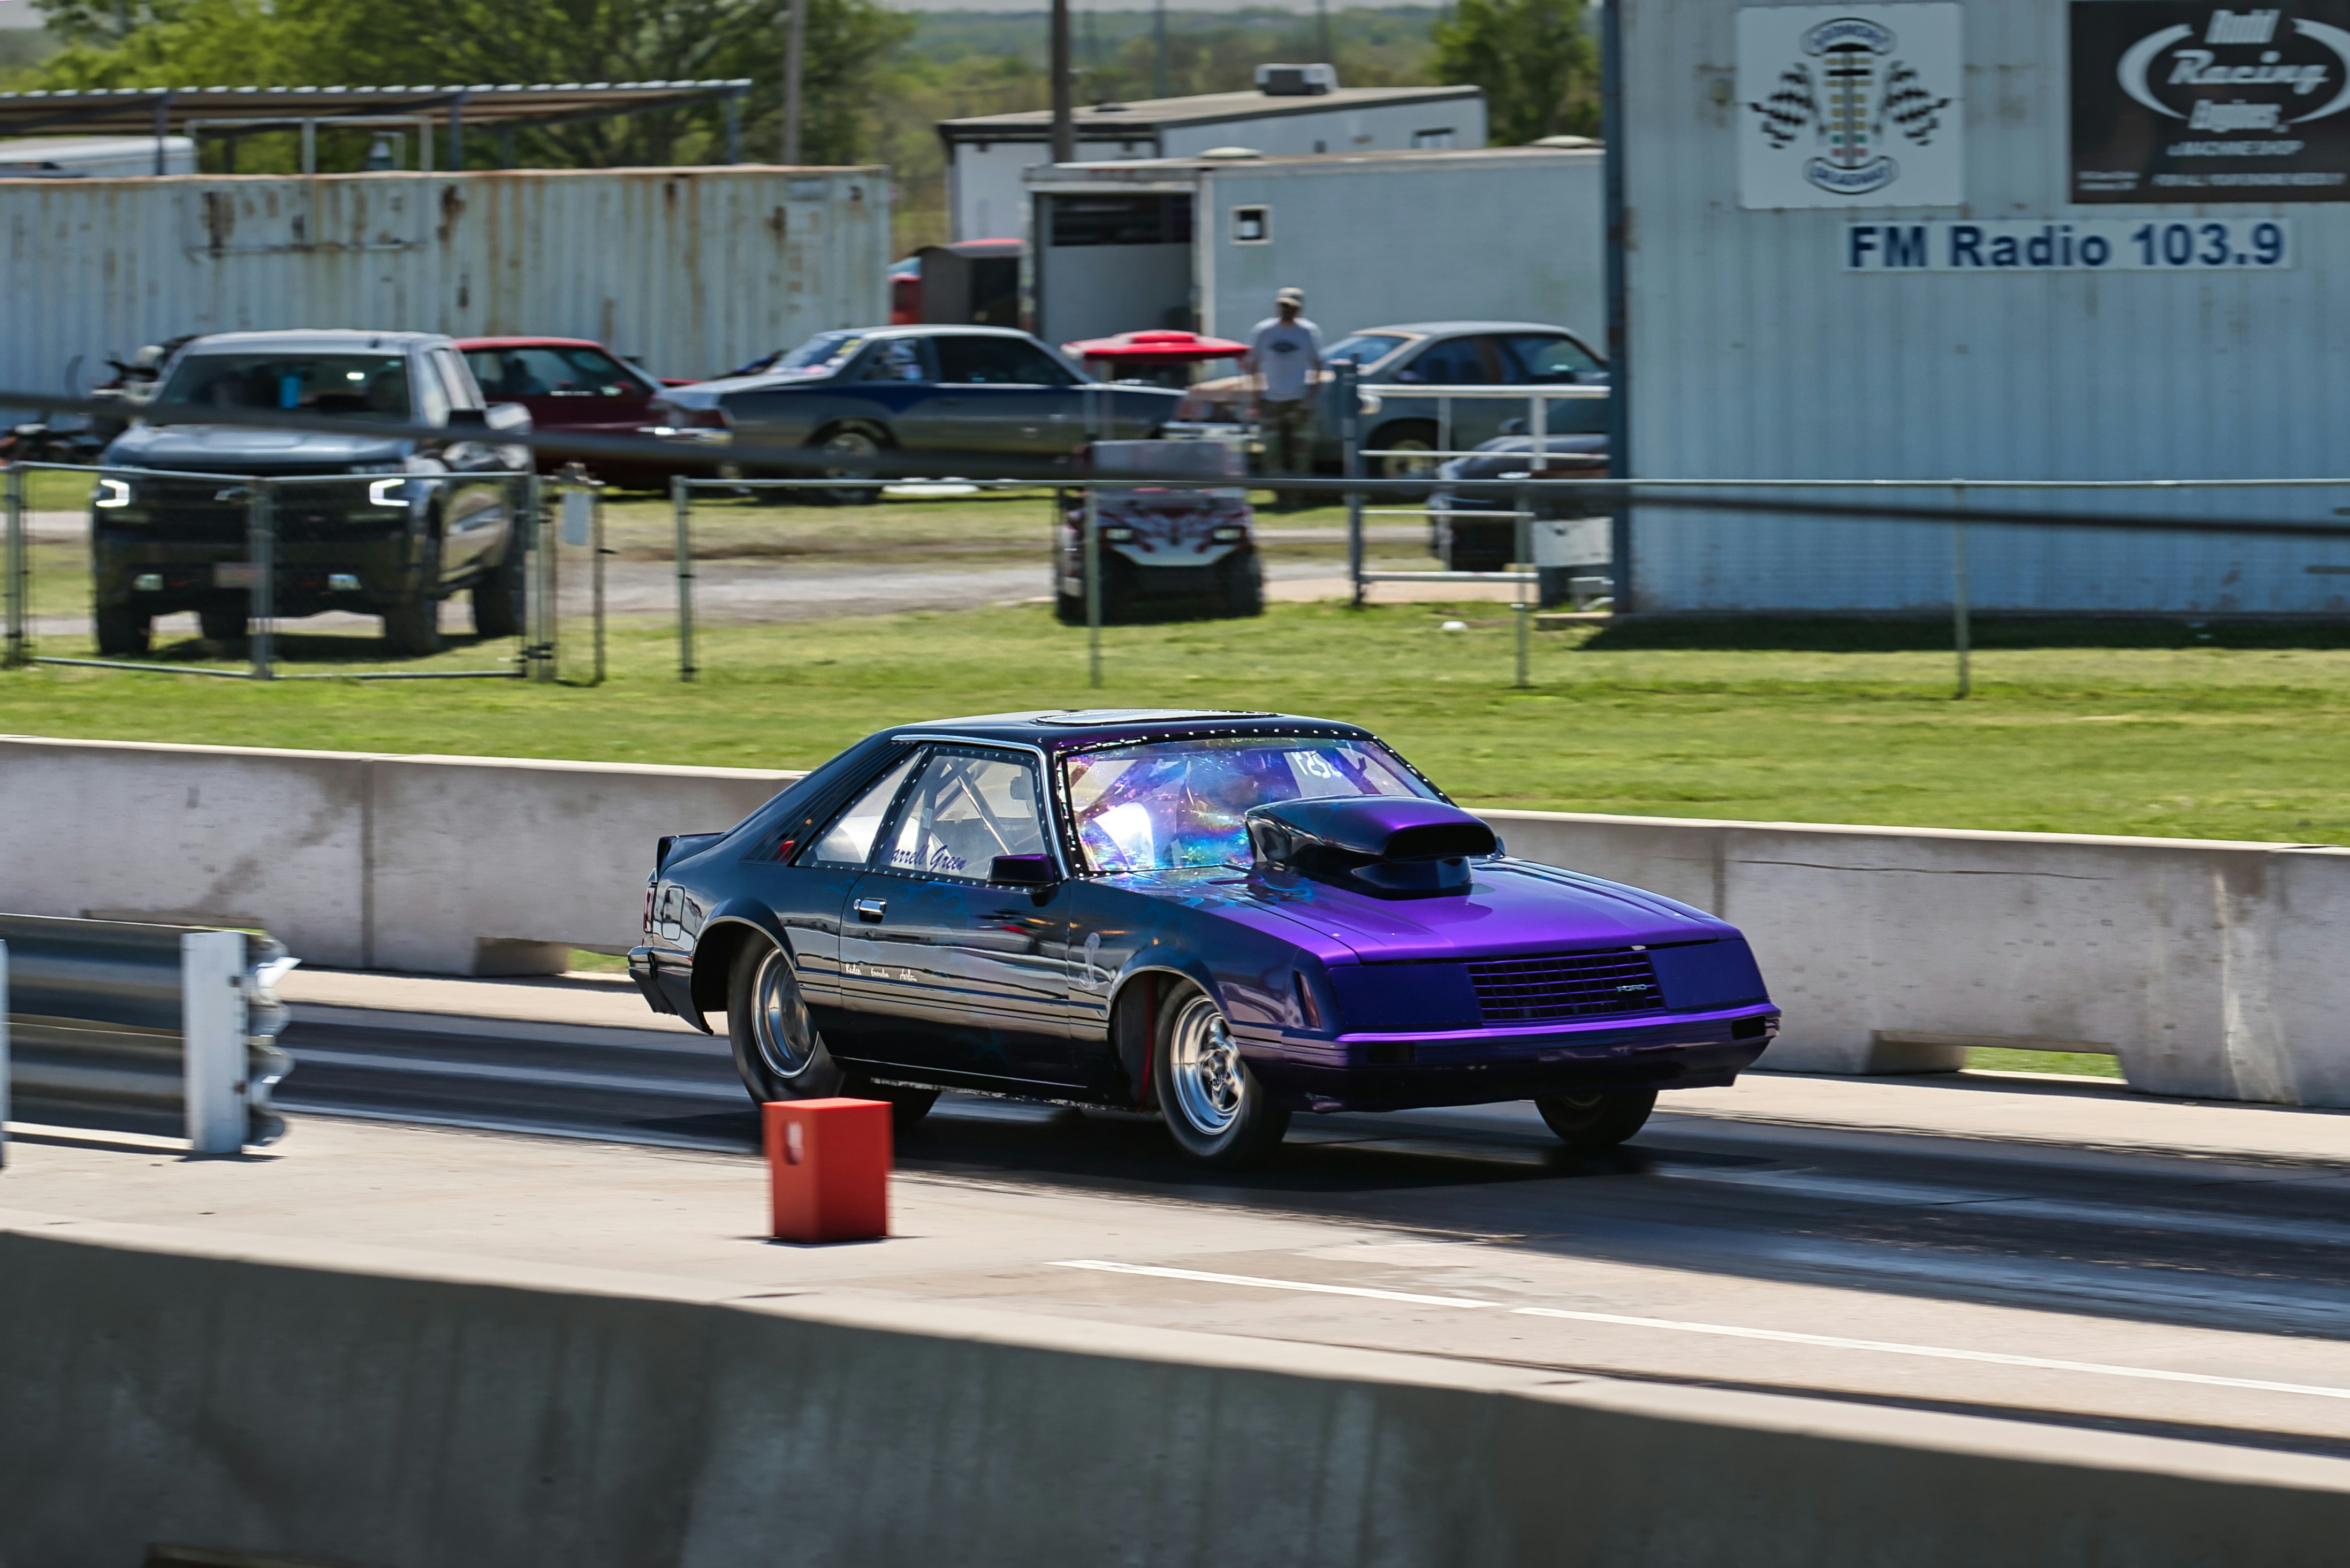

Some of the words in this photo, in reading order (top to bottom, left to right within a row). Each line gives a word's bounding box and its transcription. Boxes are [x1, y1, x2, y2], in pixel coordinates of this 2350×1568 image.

[2167, 49, 2331, 95] Racing
[1848, 225, 1926, 268] FM
[1949, 223, 2112, 267] Radio
[2129, 222, 2284, 266] 103.9
[925, 844, 968, 878] Green
[1616, 984, 1647, 993] FORD
